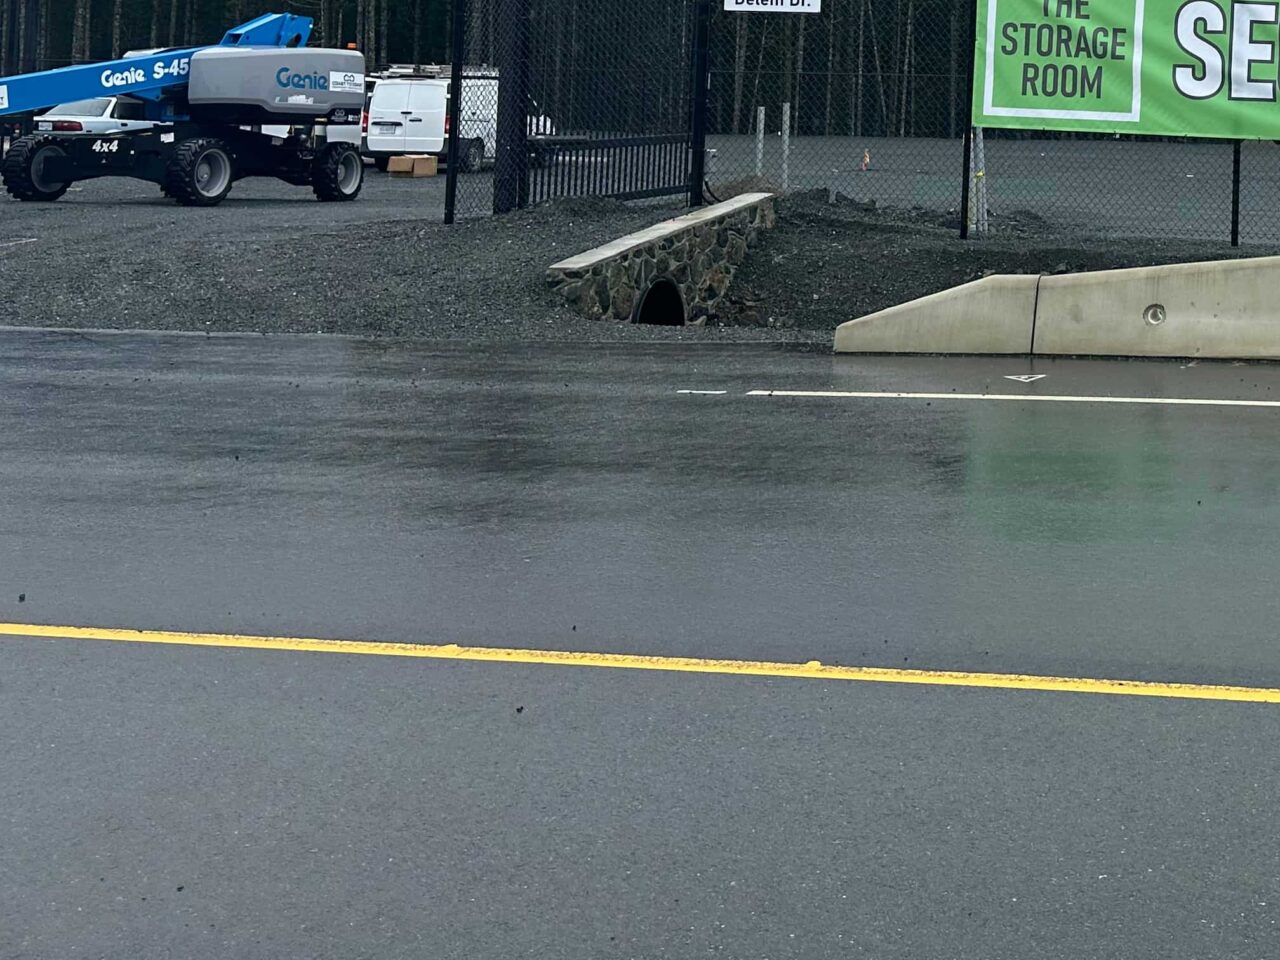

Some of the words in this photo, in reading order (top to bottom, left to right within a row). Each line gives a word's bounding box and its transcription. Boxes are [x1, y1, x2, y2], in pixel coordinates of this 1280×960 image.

[1001, 22, 1127, 60] STORAGE
[101, 67, 145, 87] Genie
[153, 58, 189, 79] S-45
[275, 67, 328, 90] Genie
[1021, 63, 1103, 99] ROOM
[92, 140, 119, 152] 4x4
